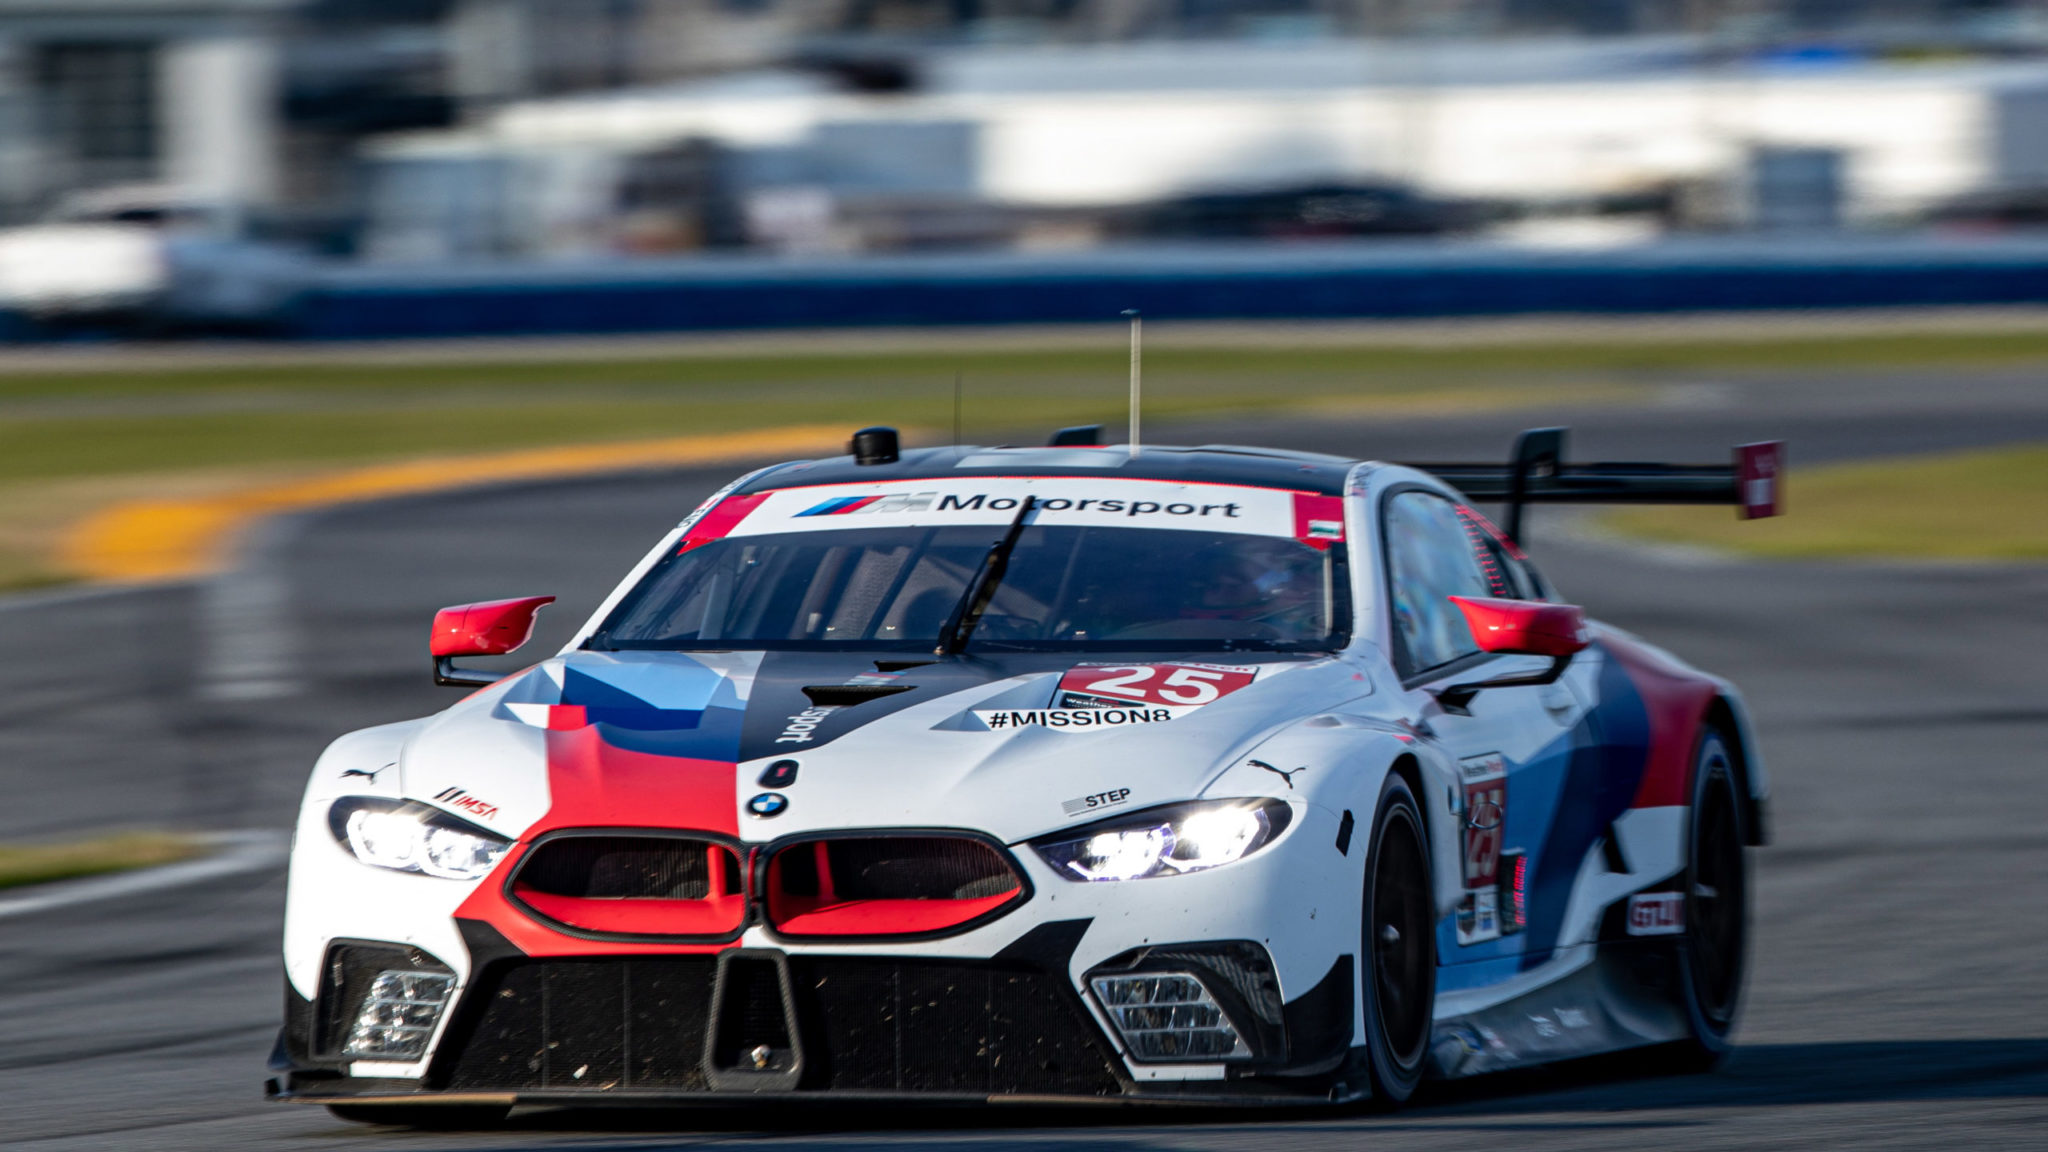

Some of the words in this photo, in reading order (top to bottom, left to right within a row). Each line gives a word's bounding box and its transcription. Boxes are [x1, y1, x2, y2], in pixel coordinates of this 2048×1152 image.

[1086, 666, 1220, 705] 25
[989, 709, 1171, 729] #MISSION8
[452, 795, 499, 820] IMSA
[1085, 788, 1131, 807] STEP
